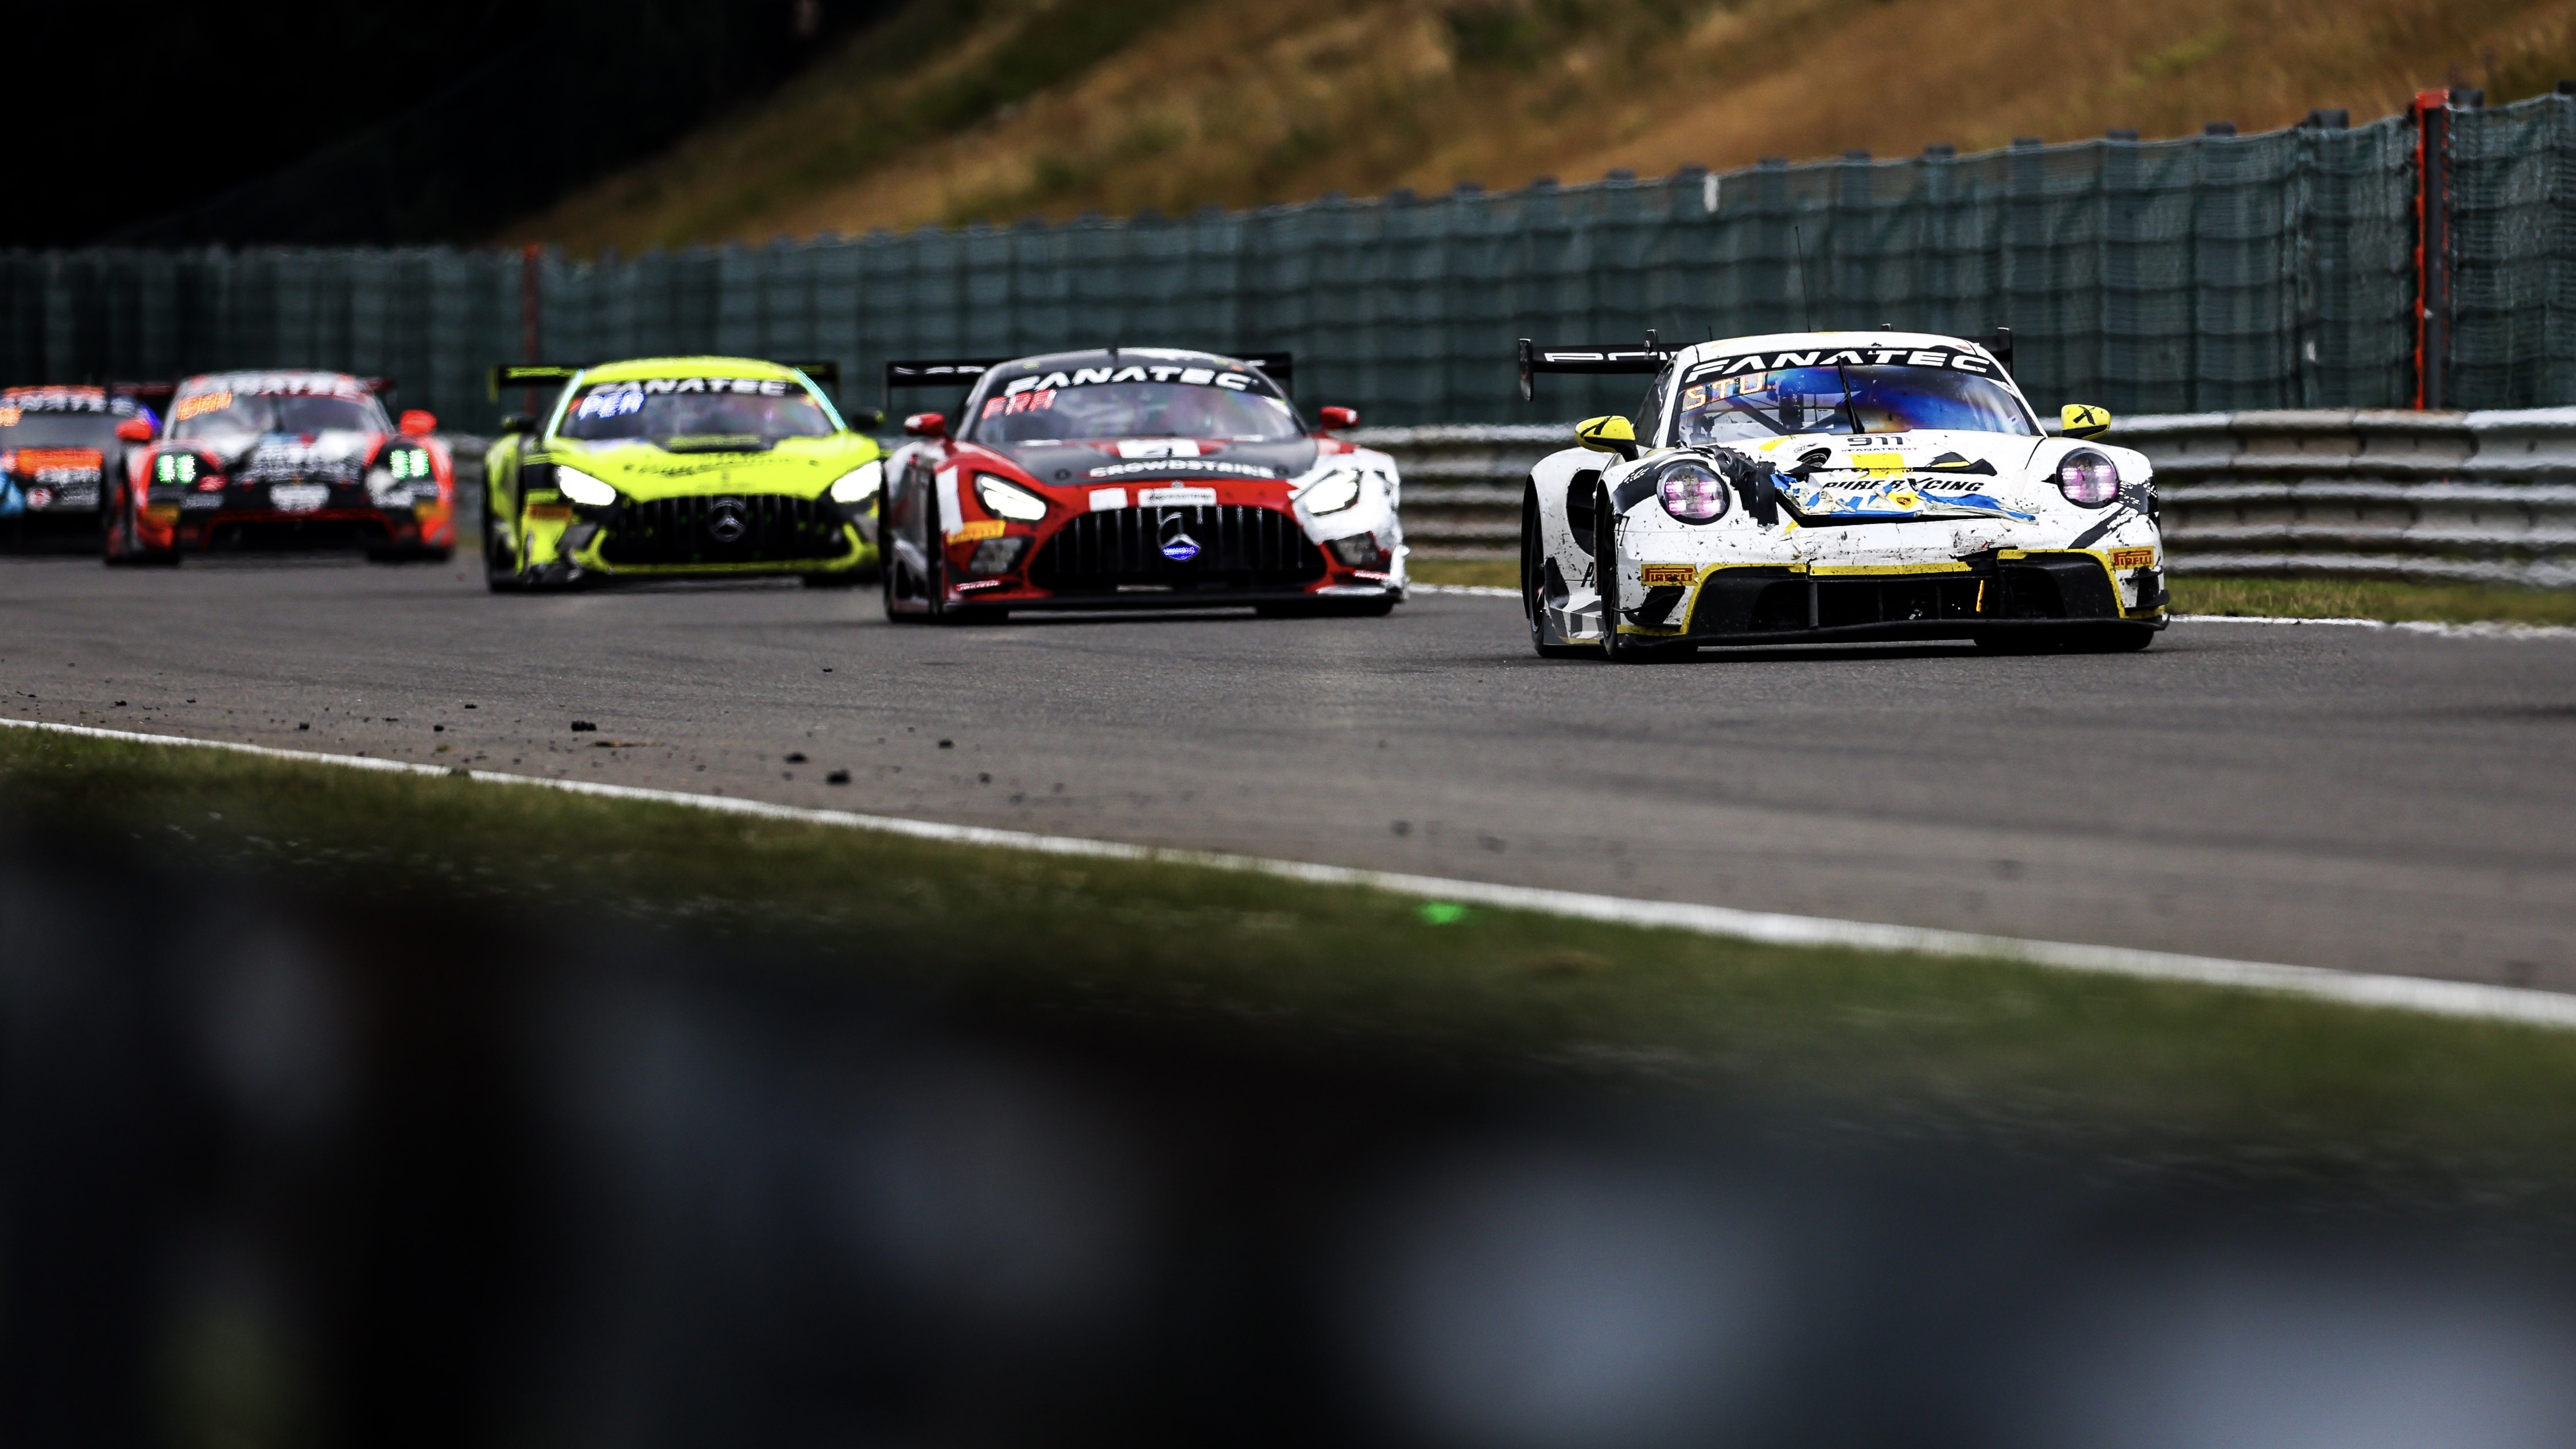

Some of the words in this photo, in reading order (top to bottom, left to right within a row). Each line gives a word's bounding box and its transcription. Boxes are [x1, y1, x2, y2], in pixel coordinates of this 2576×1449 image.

[1685, 350, 1991, 383] FANATEC
[1005, 366, 1254, 398] FANATEC
[1684, 372, 1764, 411] STU
[1847, 436, 1903, 446] 911
[2113, 550, 2152, 566] PIRELLI
[1645, 568, 1693, 581] PIRELLI
